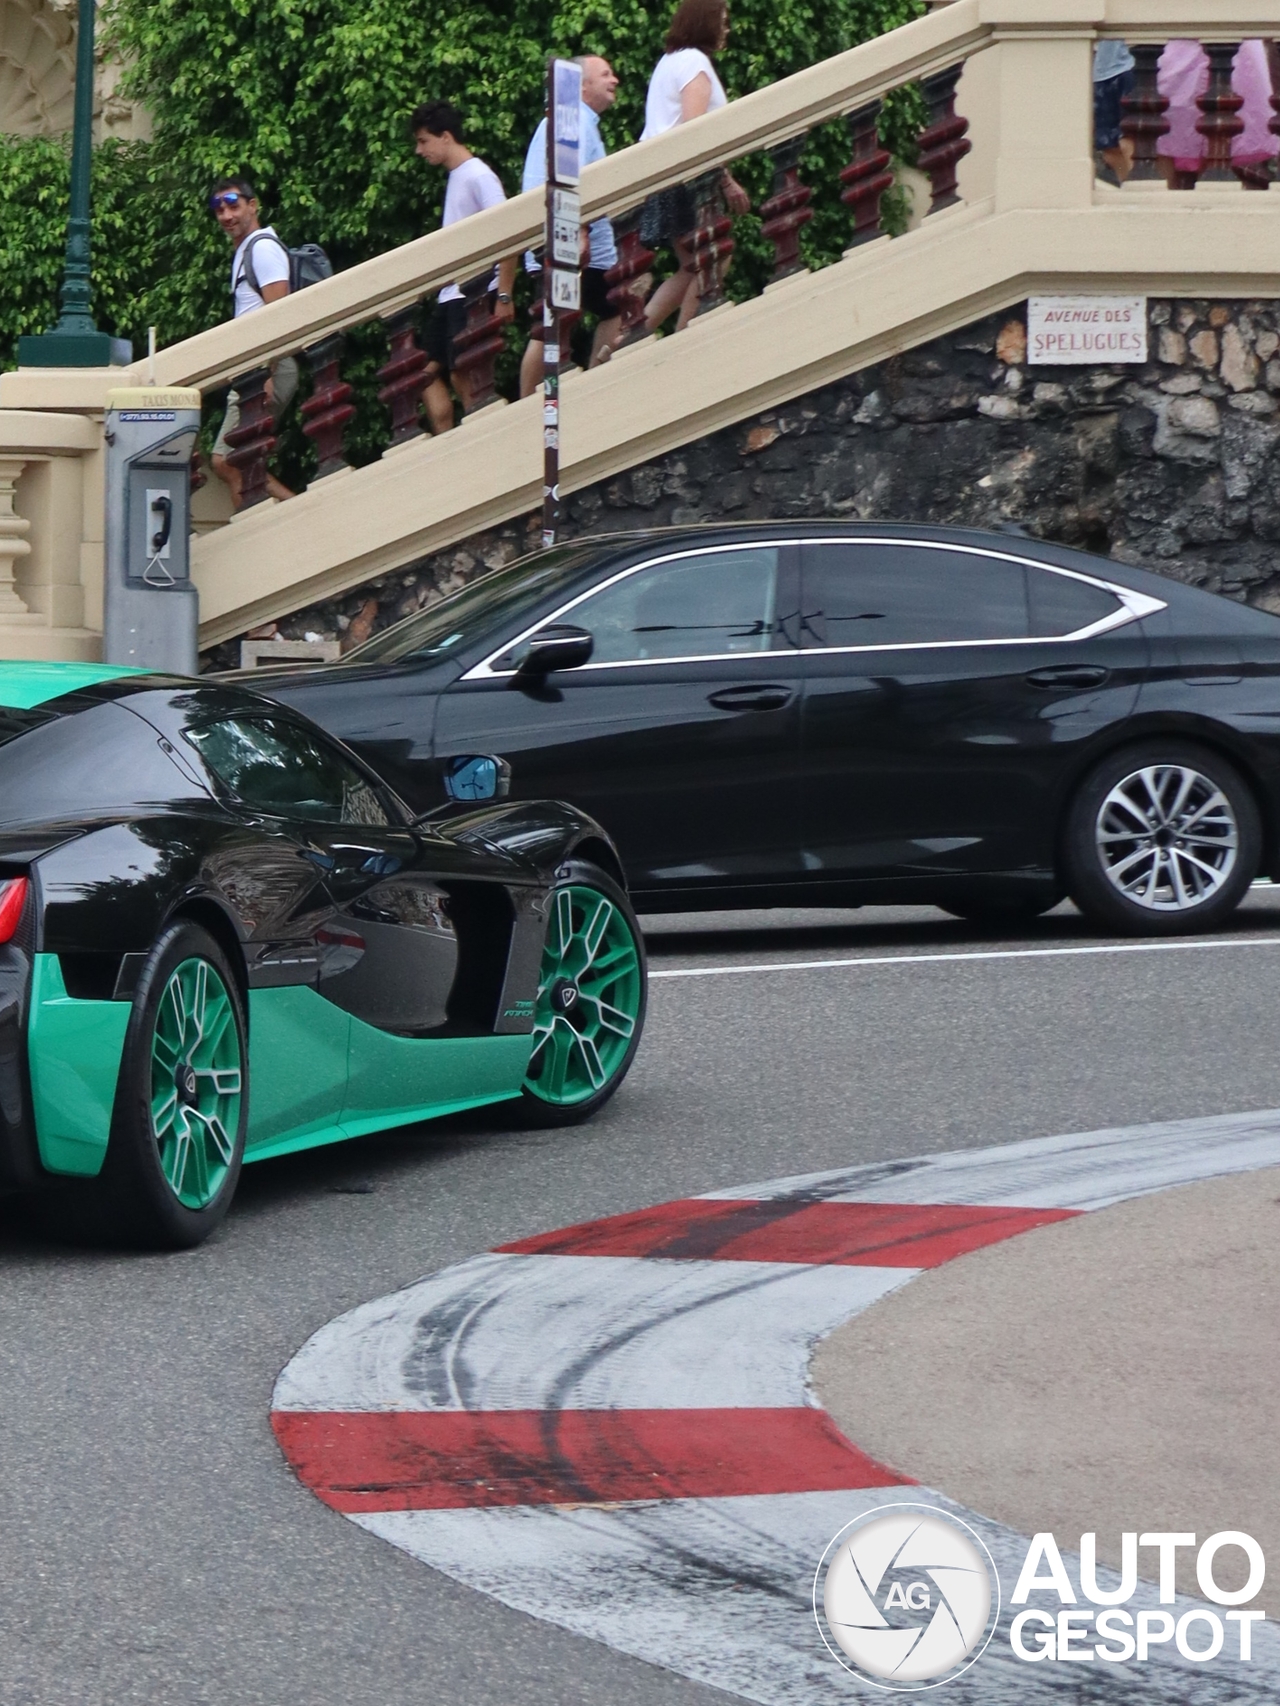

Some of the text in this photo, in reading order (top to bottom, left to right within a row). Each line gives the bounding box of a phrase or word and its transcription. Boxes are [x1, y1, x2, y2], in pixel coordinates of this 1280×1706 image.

[1044, 309, 1131, 322] AVENUE DES
[1033, 332, 1142, 350] SPELUGUES
[141, 392, 200, 407] TAXIS MONA
